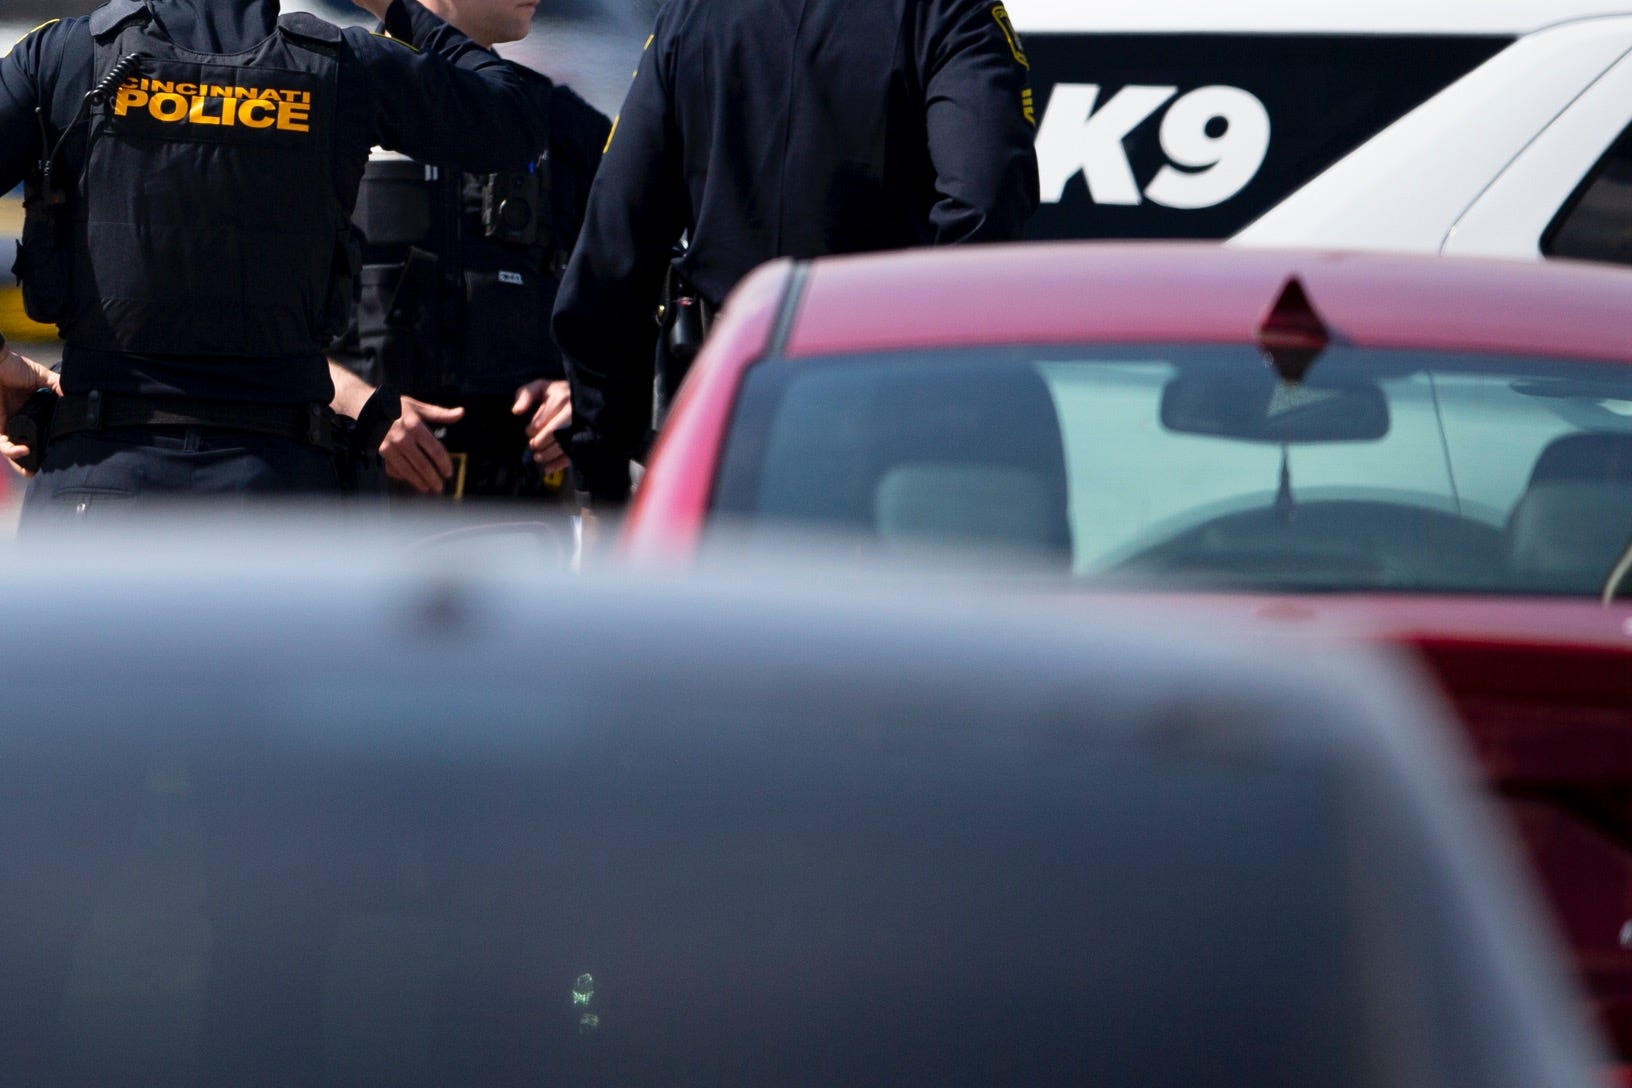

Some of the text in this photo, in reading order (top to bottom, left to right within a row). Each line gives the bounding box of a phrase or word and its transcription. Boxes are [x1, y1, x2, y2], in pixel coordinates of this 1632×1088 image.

[114, 88, 311, 132] POLICE
[119, 77, 311, 104] CINCINNATI
[1035, 83, 1271, 210] K9
